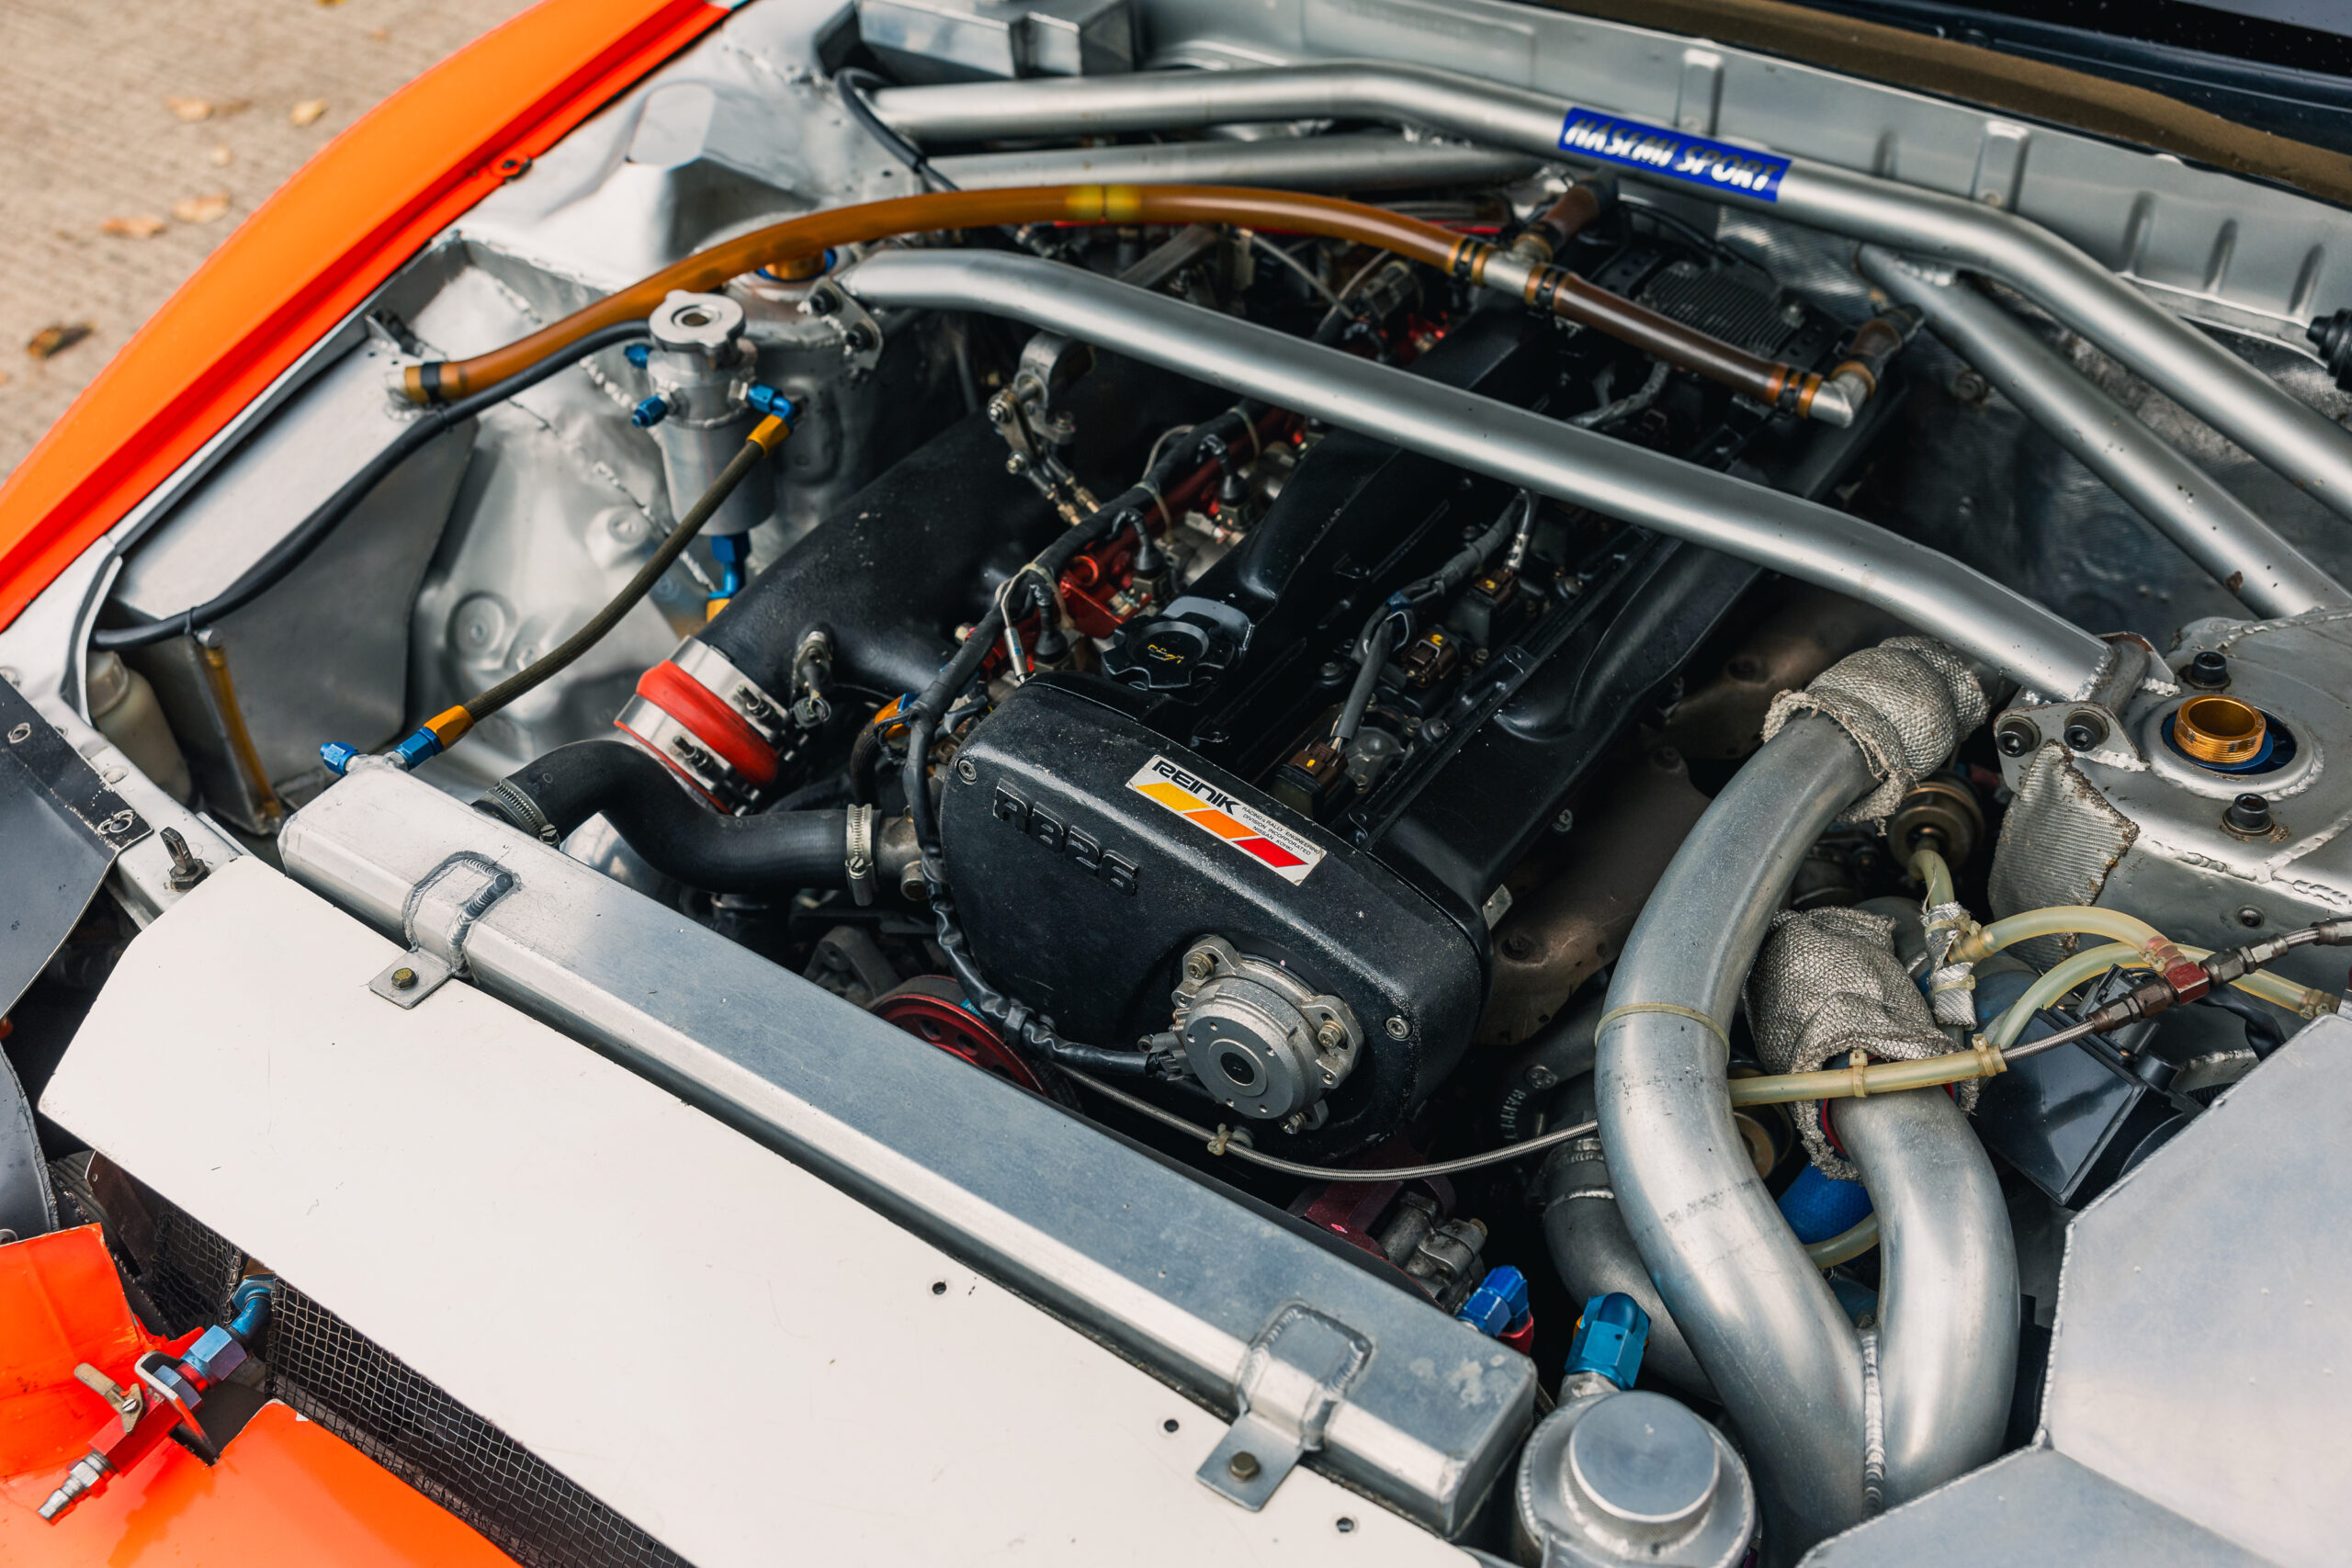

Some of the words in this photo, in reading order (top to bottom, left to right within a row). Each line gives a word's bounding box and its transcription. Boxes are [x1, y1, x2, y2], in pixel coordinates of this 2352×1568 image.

[1564, 118, 1680, 167] HASEMI
[1674, 145, 1781, 191] SPORT
[1152, 760, 1241, 816] REINIK
[993, 778, 1139, 897] RB26
[1242, 807, 1262, 820] RACING
[1266, 819, 1284, 832] RALLY
[1284, 831, 1321, 854] ENGINEERING
[1242, 813, 1267, 829] DIVISION
[1268, 829, 1311, 855] INCORPORATED
[1252, 826, 1274, 840] NISSAN
[1275, 840, 1294, 852] KOHKI
